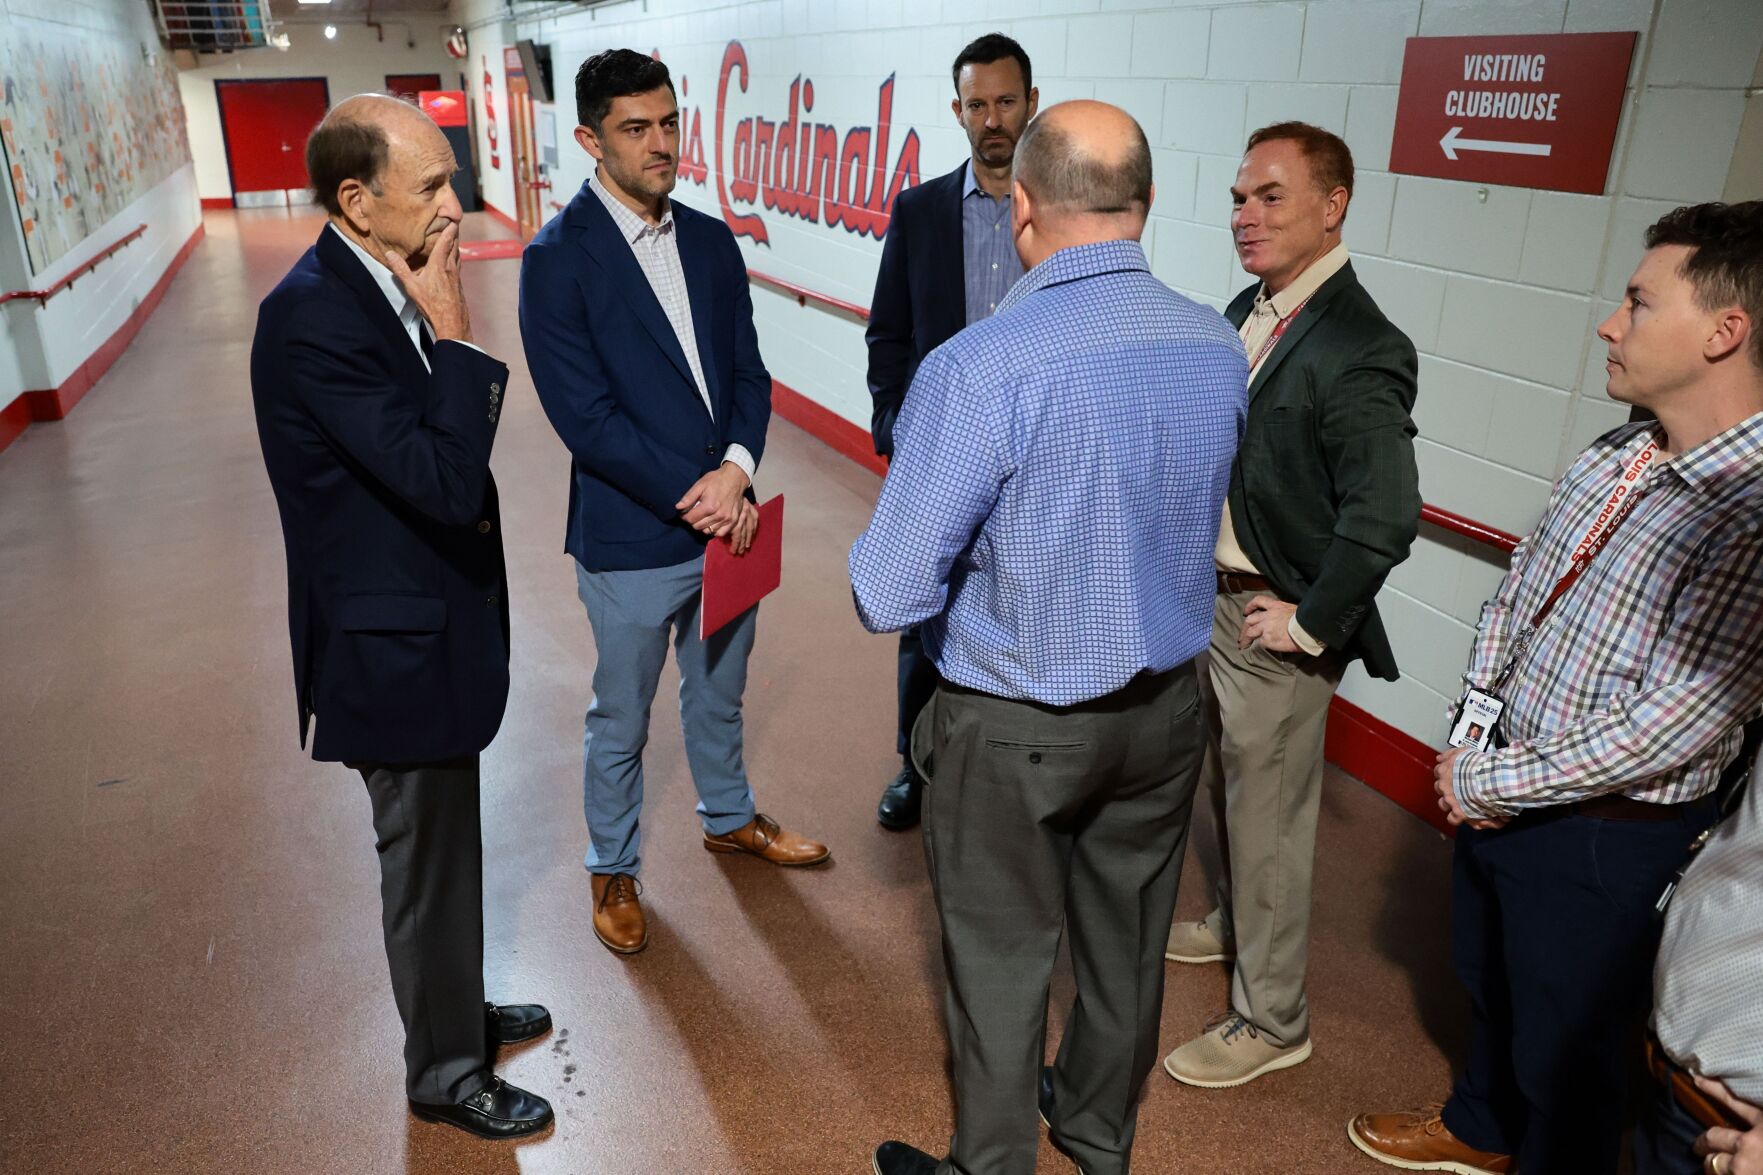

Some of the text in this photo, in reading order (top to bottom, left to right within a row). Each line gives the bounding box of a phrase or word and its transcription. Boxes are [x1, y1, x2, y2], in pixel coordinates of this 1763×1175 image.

[1464, 54, 1545, 82] VISITING
[1445, 90, 1560, 121] CLUBHOUSE
[715, 39, 921, 249] Cardinals
[1571, 443, 1658, 562] LOUIS CARDINALS
[1606, 494, 1638, 534] LOUIS
